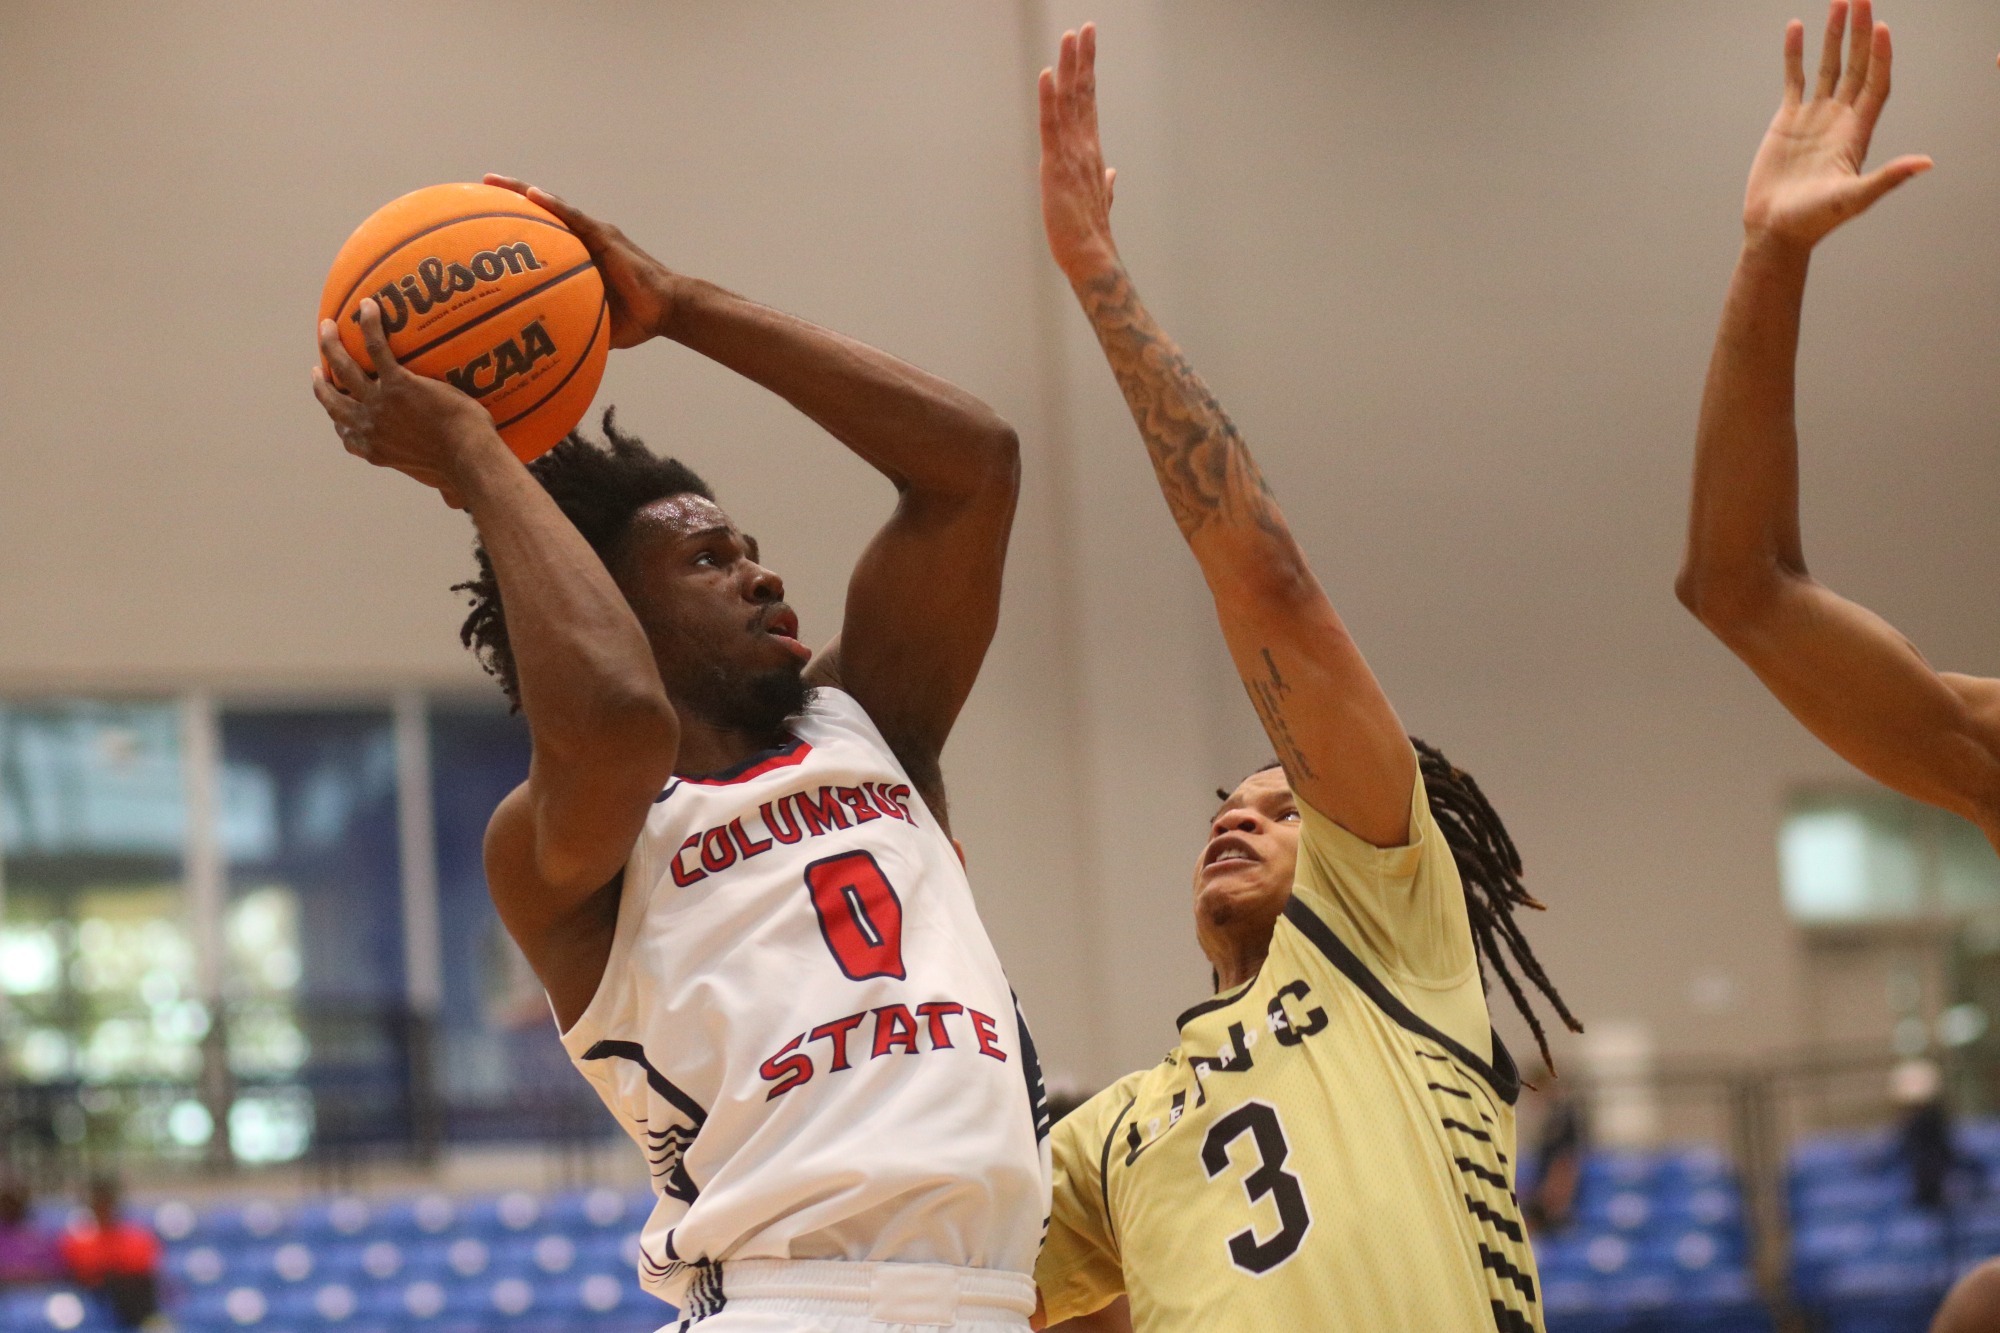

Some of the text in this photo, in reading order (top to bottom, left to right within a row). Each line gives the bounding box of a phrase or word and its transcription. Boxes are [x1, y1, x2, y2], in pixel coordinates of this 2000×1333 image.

[350, 241, 542, 339] Wilson
[669, 781, 919, 888] COLUMBUS
[803, 848, 907, 982] 0
[758, 1001, 1007, 1103] STATE
[1200, 1098, 1314, 1279] 3
